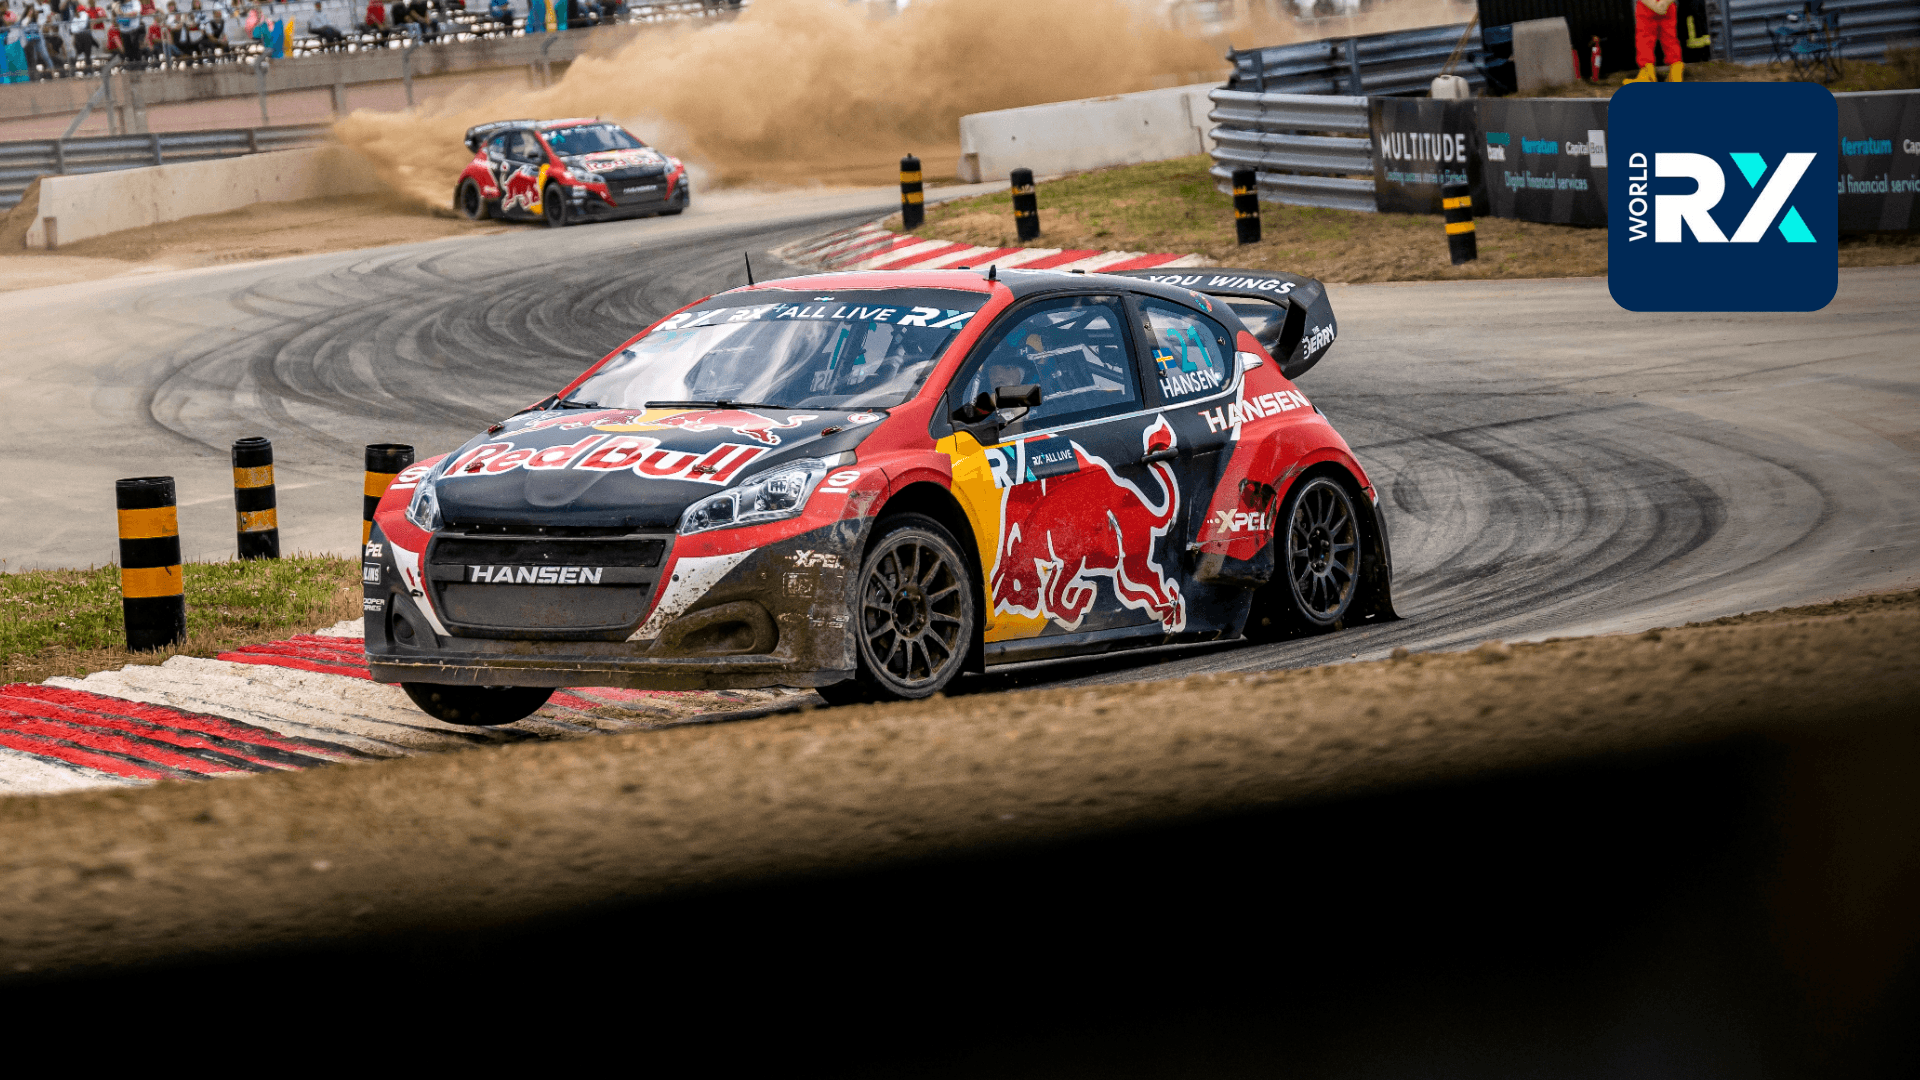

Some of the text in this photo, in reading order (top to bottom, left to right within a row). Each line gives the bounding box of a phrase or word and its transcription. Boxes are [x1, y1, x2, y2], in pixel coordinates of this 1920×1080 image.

[1380, 132, 1467, 163] MULTITUDE
[1841, 136, 1893, 156] ferratum
[1847, 173, 1888, 194] financial
[1208, 275, 1296, 294] WINGS
[831, 306, 897, 321] LIVE
[1166, 325, 1213, 372] 21
[1301, 323, 1335, 360] BERRY
[1160, 368, 1219, 399] HANSEN
[1198, 389, 1311, 434] HANSEN
[440, 434, 772, 487] Red Bull
[984, 439, 1038, 489] RX
[1056, 449, 1073, 461] LIVE
[468, 565, 603, 586] HANSEN
